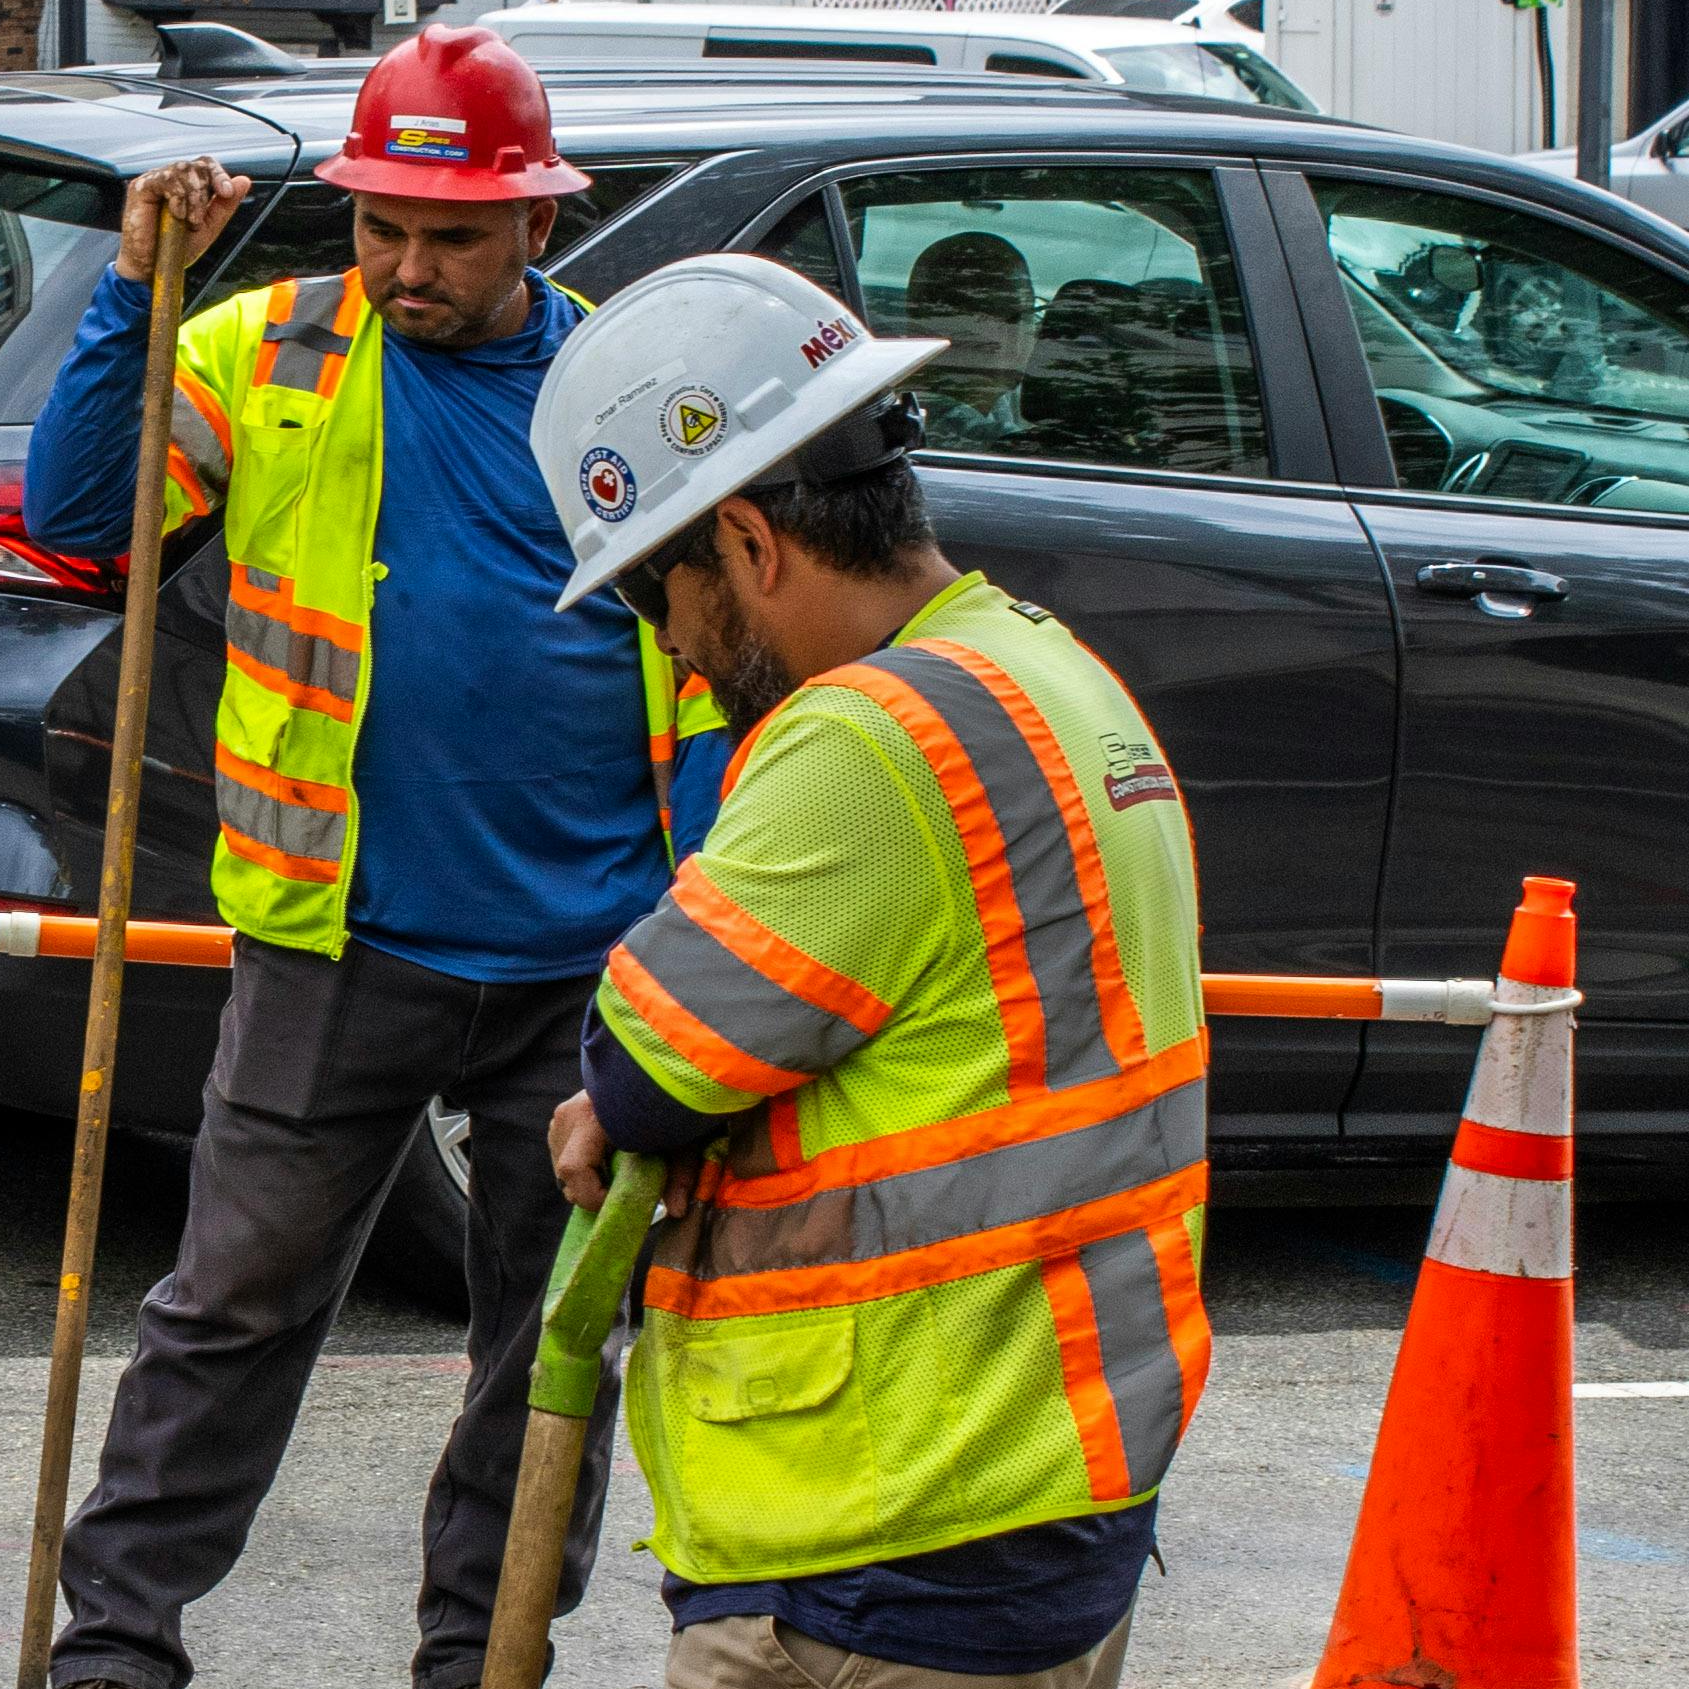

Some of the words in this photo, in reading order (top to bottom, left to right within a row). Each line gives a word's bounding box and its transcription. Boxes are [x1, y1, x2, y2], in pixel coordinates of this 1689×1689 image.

[595, 402, 617, 425] Omar
[583, 450, 608, 471] FIRST
[610, 453, 629, 475] AID
[595, 484, 636, 519] CERTIFIED
